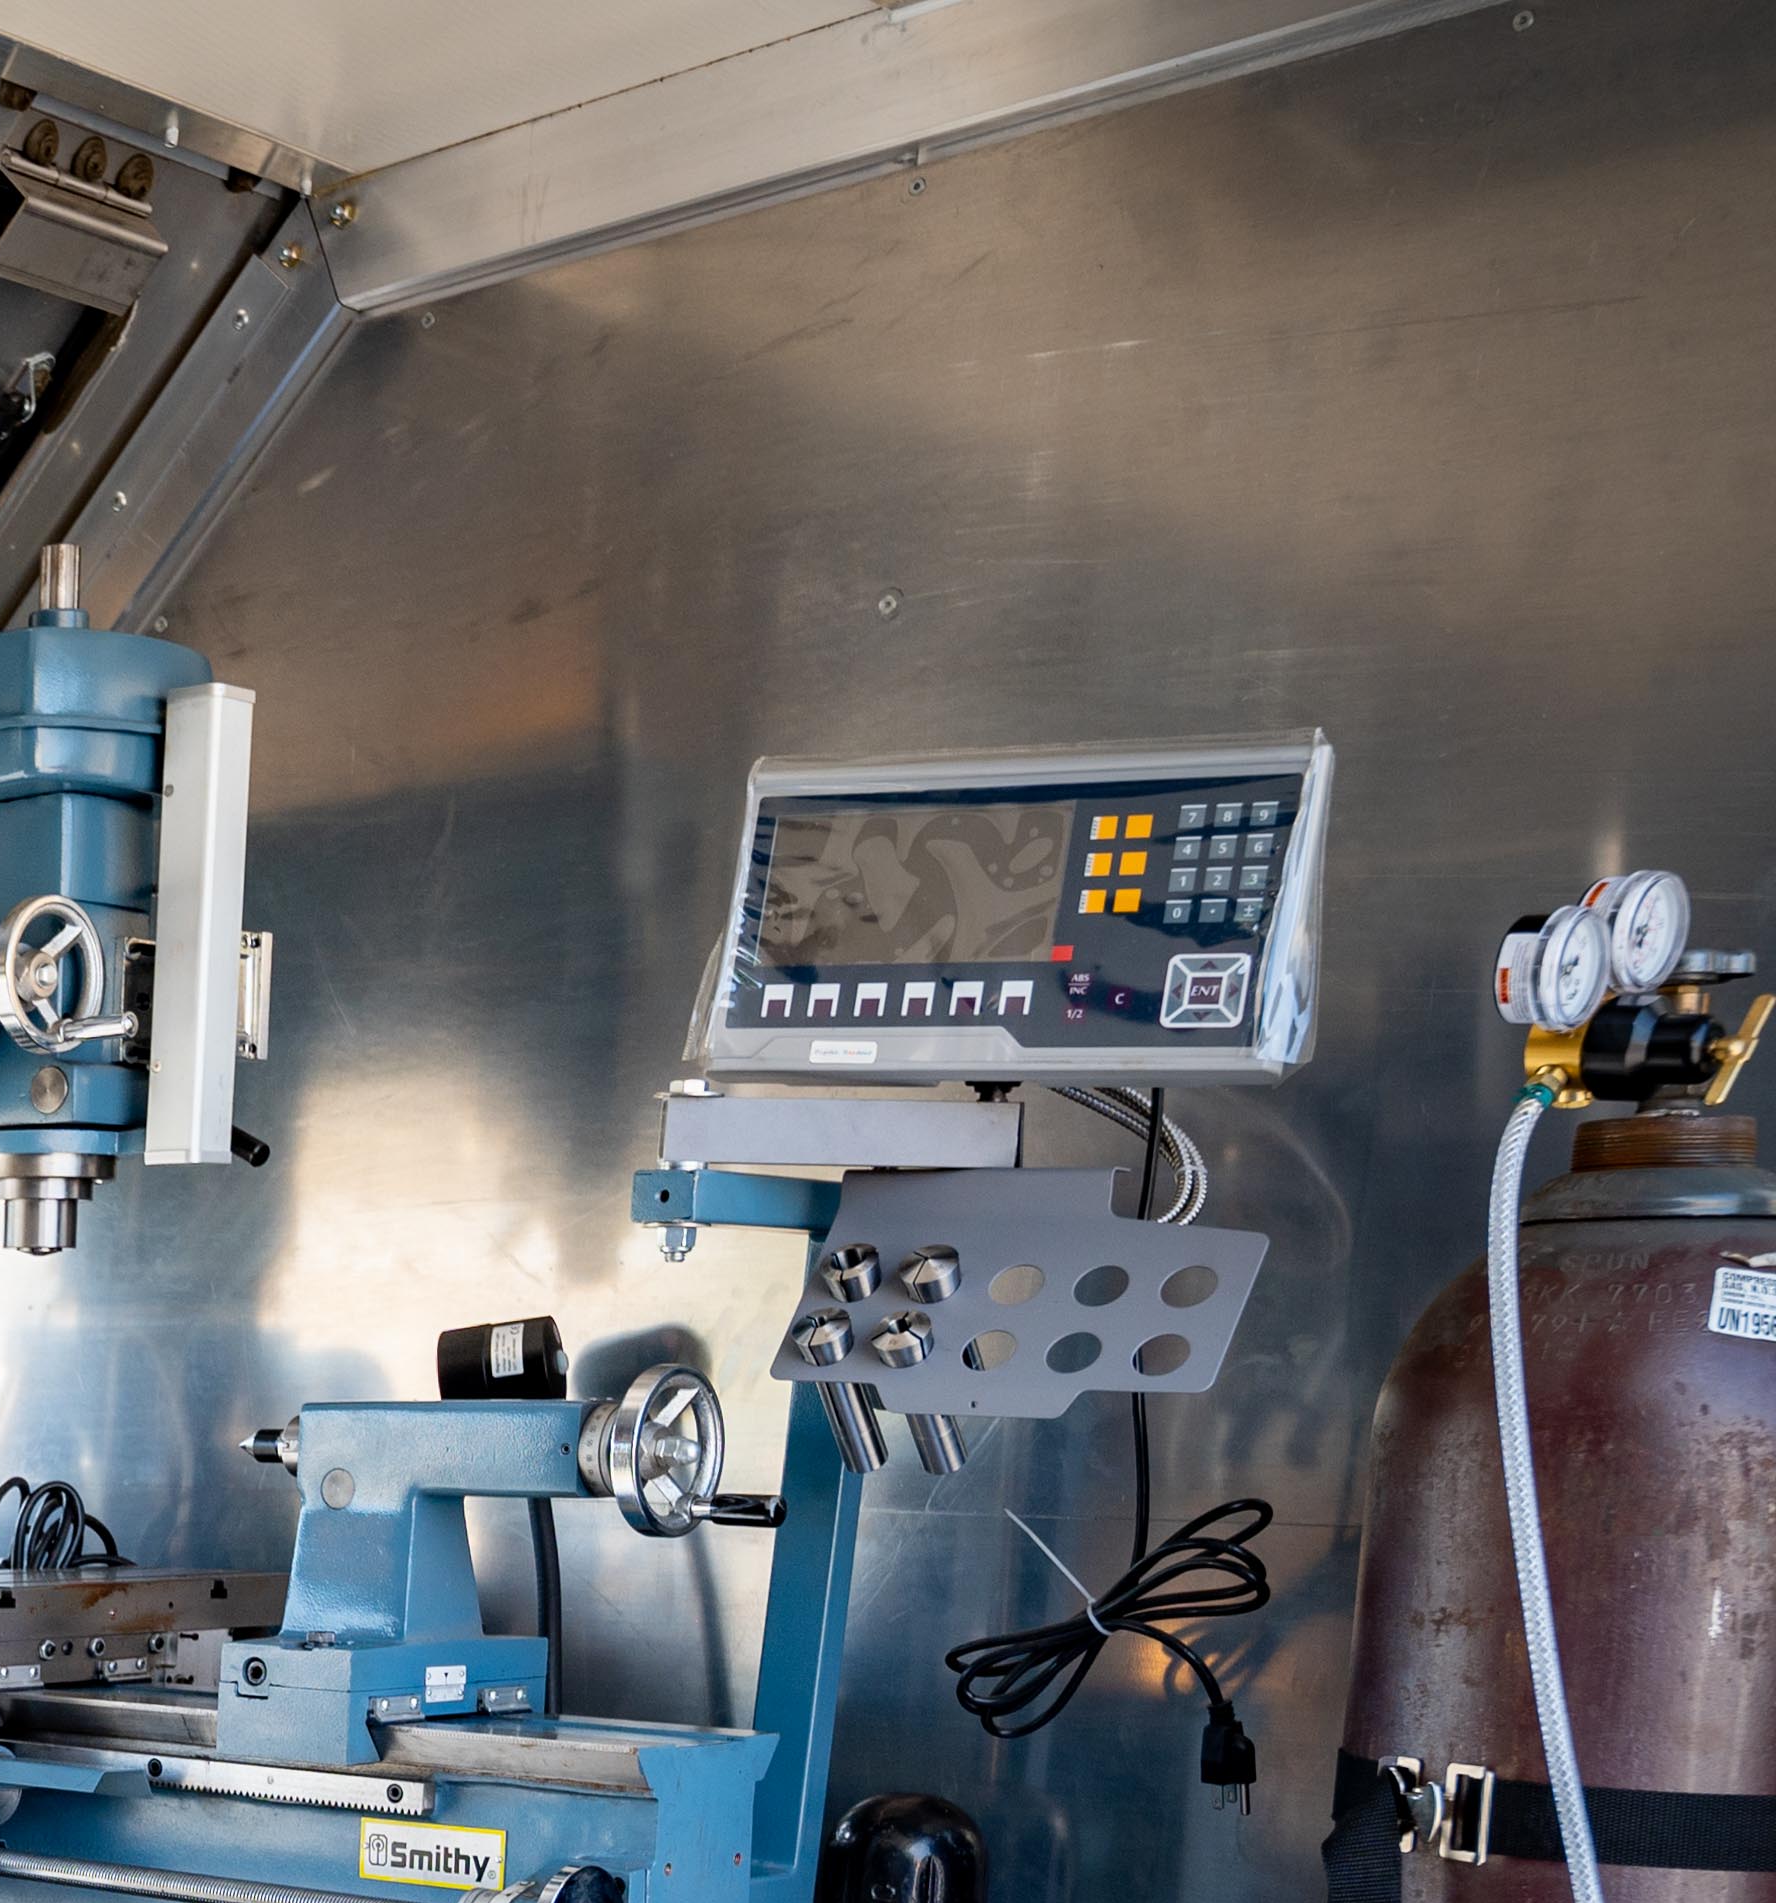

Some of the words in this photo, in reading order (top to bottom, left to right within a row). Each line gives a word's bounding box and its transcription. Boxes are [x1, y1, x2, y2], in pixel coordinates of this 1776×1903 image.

[1188, 812, 1197, 823] 7
[1223, 810, 1233, 822] 8
[1259, 809, 1269, 821] 9
[1182, 843, 1192, 854] 4
[1218, 842, 1228, 854] 5
[1254, 841, 1264, 853] 6
[1179, 875, 1187, 887] 1
[1213, 875, 1223, 887] 2
[1248, 873, 1258, 886] 3
[1172, 907, 1181, 919] 0
[1071, 973, 1091, 983] ABS
[1069, 986, 1088, 995] INC
[1190, 984, 1219, 997] ENT
[1115, 994, 1125, 1005] C
[1066, 1009, 1084, 1019] 1/2
[1608, 1283, 1698, 1304] 7703
[390, 1842, 490, 1882] Smithy
